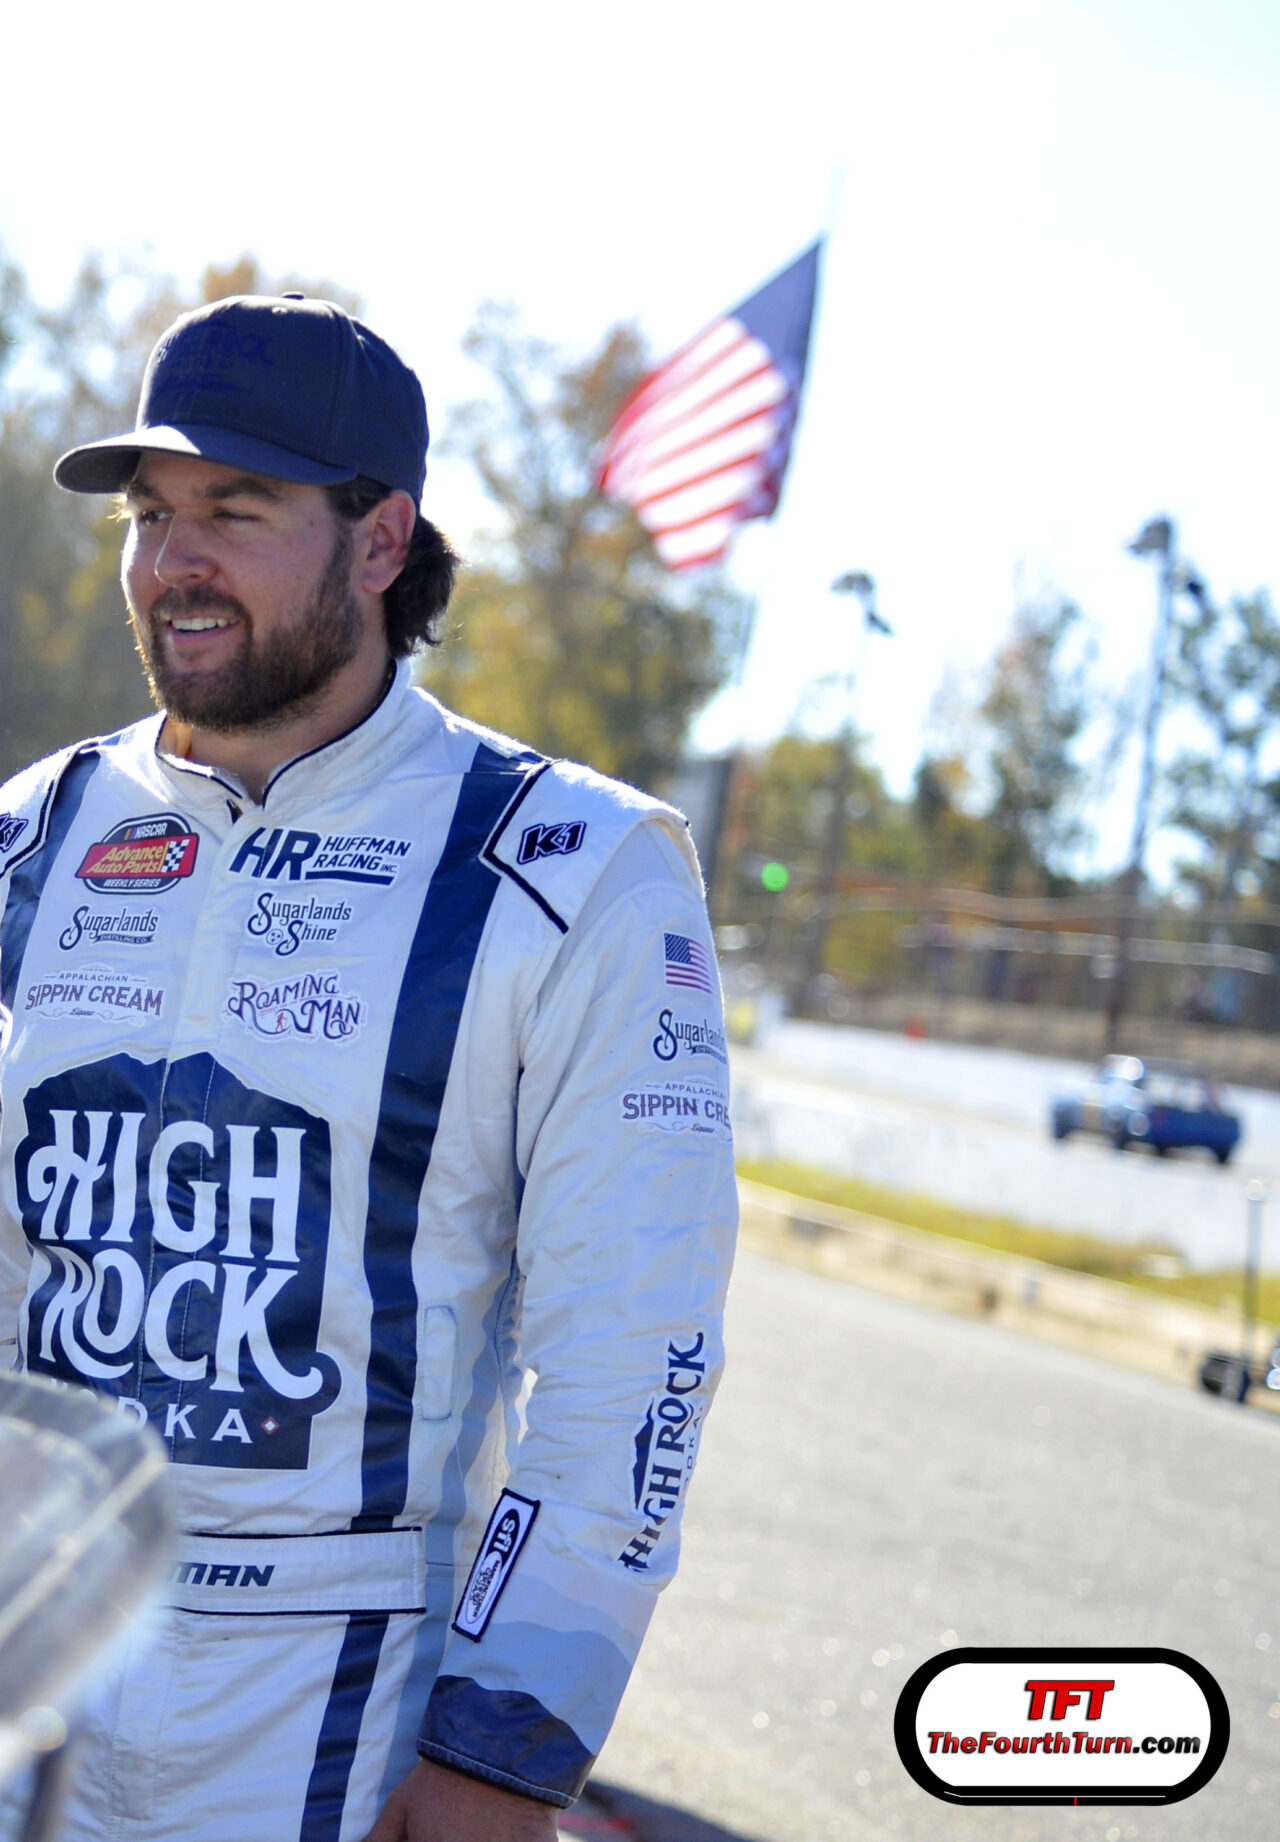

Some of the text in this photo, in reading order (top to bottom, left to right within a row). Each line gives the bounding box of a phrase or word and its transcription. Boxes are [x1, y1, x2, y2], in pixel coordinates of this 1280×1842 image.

[135, 823, 167, 839] NASCAR
[322, 836, 412, 857] HUFFMAN
[518, 821, 586, 864] K1
[86, 861, 159, 874] Auto Parts
[101, 844, 162, 862] Advance
[229, 827, 321, 881] HR
[312, 854, 398, 874] RACING INC.
[103, 878, 161, 887] WEEKLY SERIES
[59, 905, 158, 951] Sugarlands
[247, 892, 352, 935] Sugarlands
[275, 920, 337, 956] Shine
[59, 973, 128, 982] APPALACHIAN
[88, 985, 164, 1016] CREAM
[228, 974, 339, 1034] ROAMING
[276, 999, 361, 1039] MAN
[704, 1100, 731, 1130] CRE
[27, 1109, 307, 1262] HIGH
[39, 1244, 323, 1400] ROCK
[656, 1332, 706, 1455] ROCK
[175, 1561, 275, 1587] MAN
